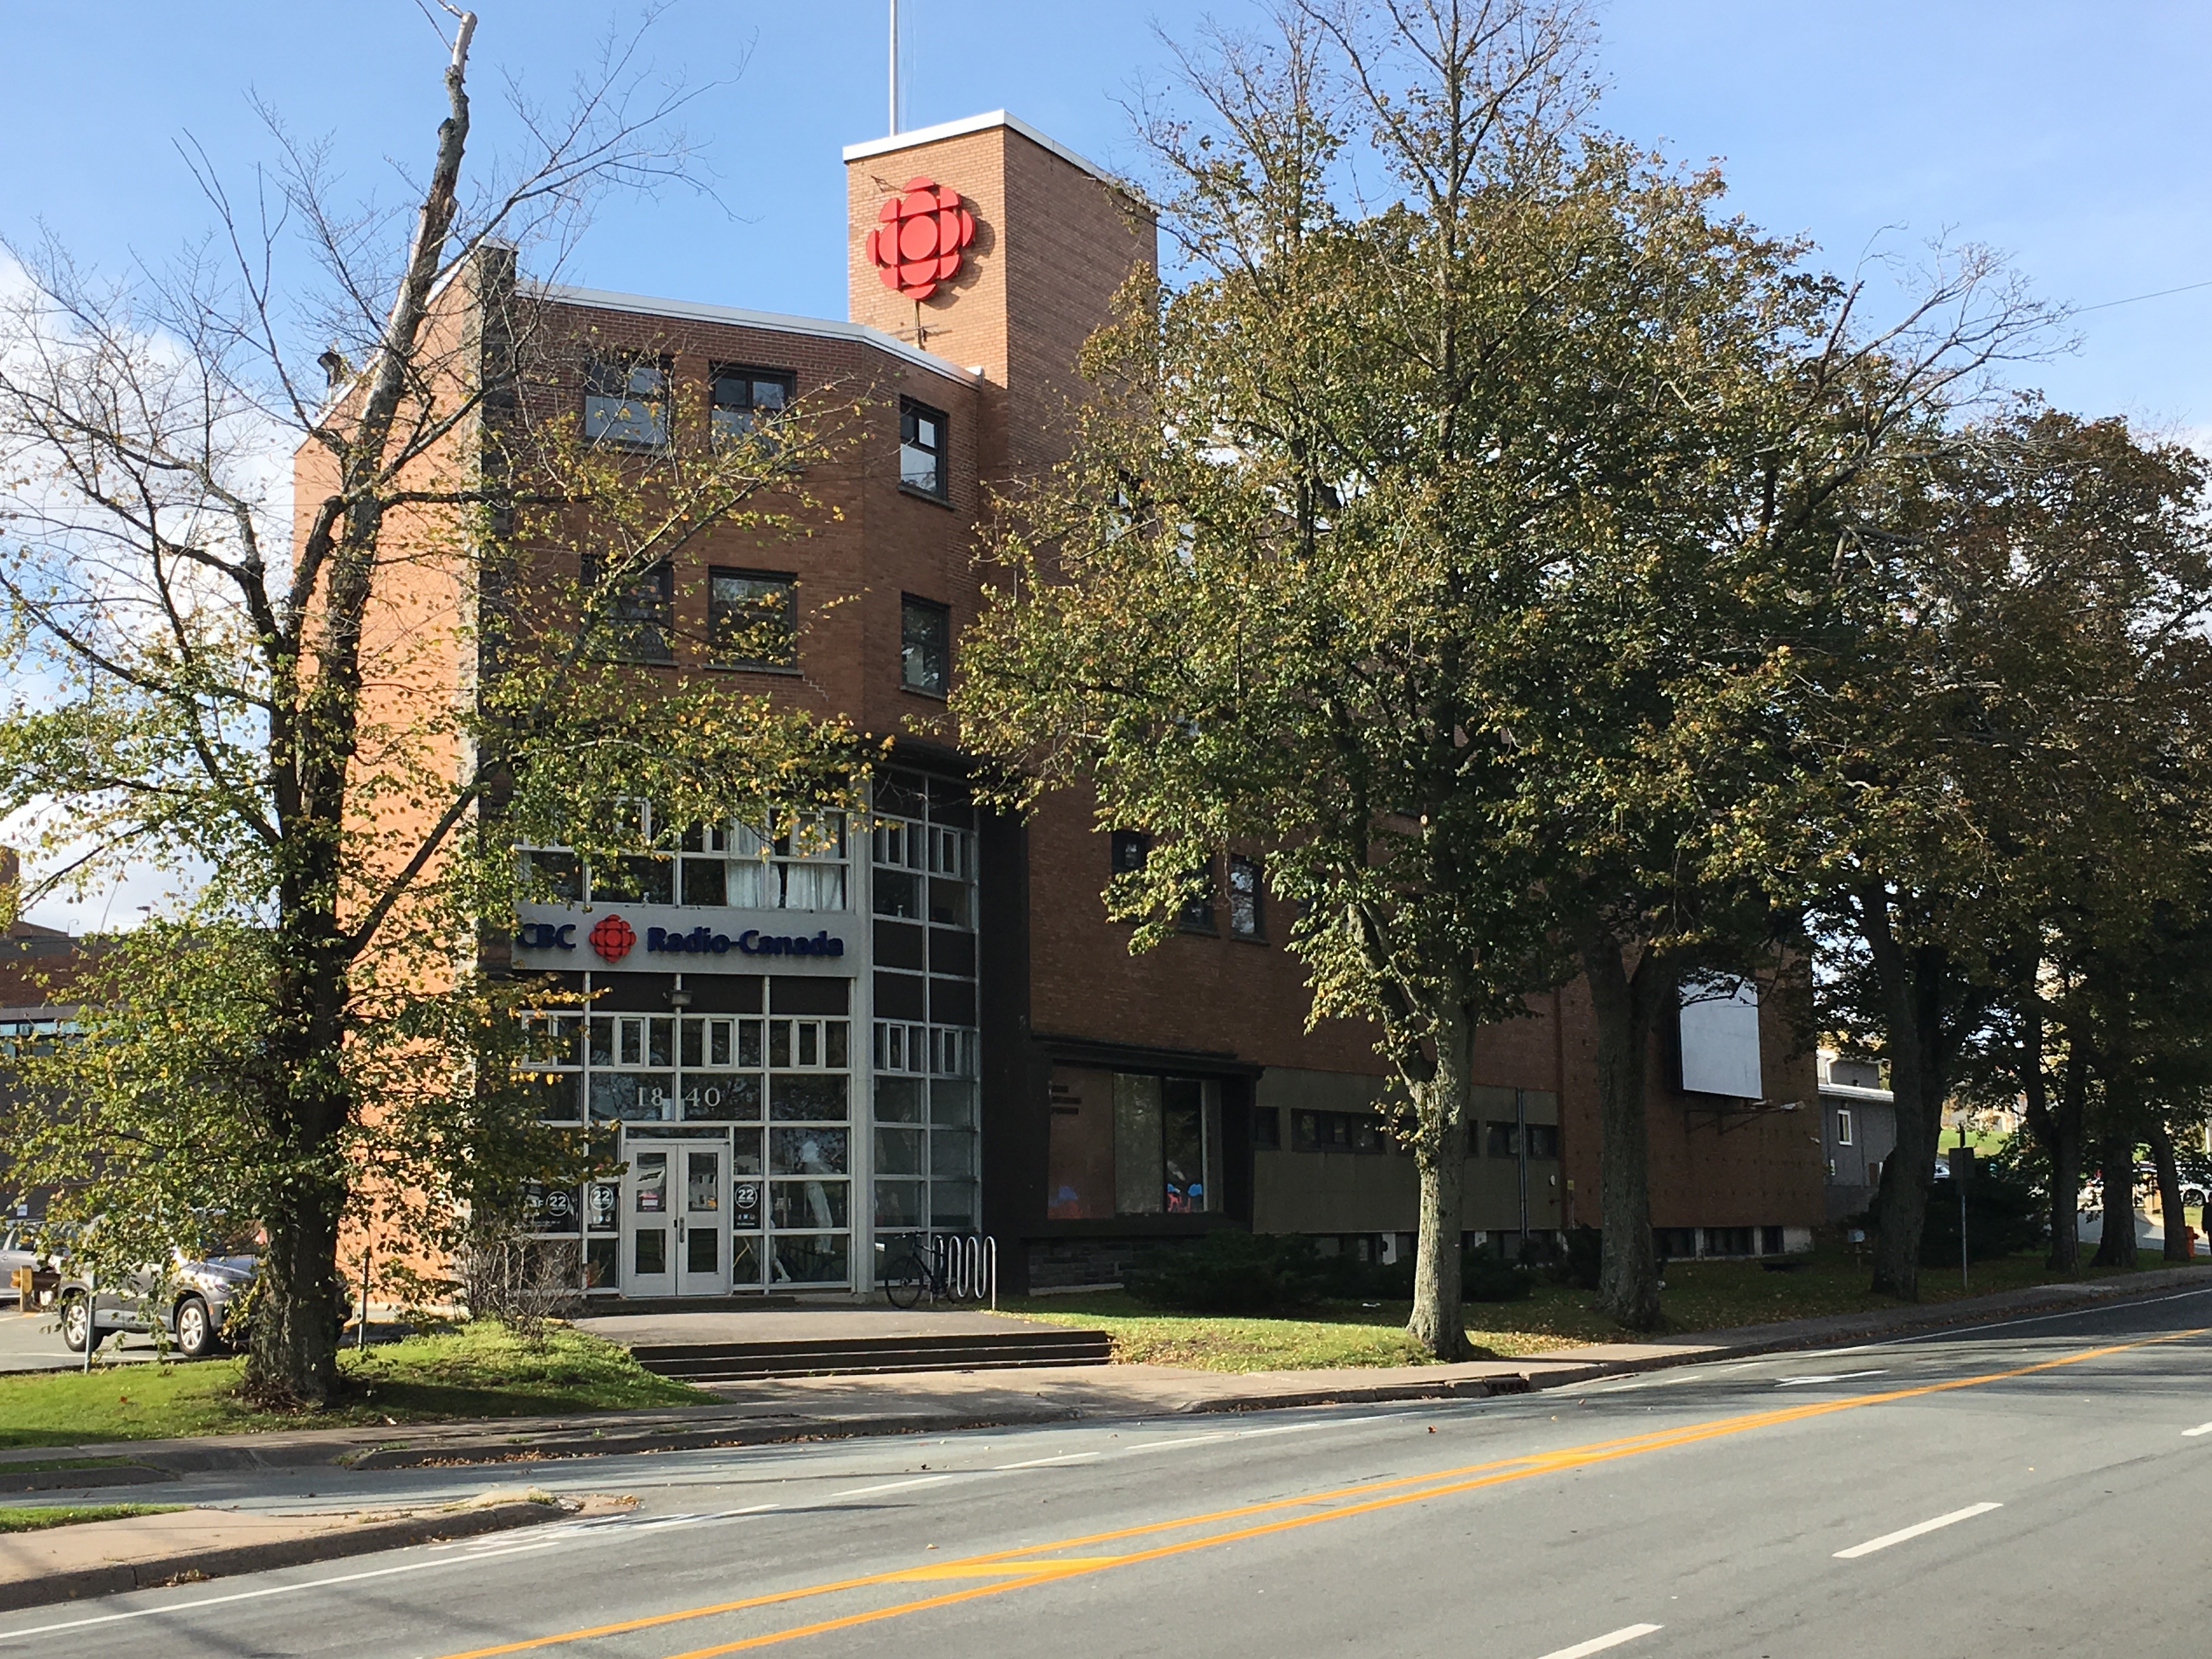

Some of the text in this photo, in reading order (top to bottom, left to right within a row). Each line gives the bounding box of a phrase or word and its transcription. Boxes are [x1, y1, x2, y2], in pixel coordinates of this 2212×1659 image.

[516, 923, 844, 956] CBC Radio-Canada
[593, 1191, 610, 1202] 22
[738, 1189, 754, 1200] 22
[549, 1196, 566, 1207] 22
